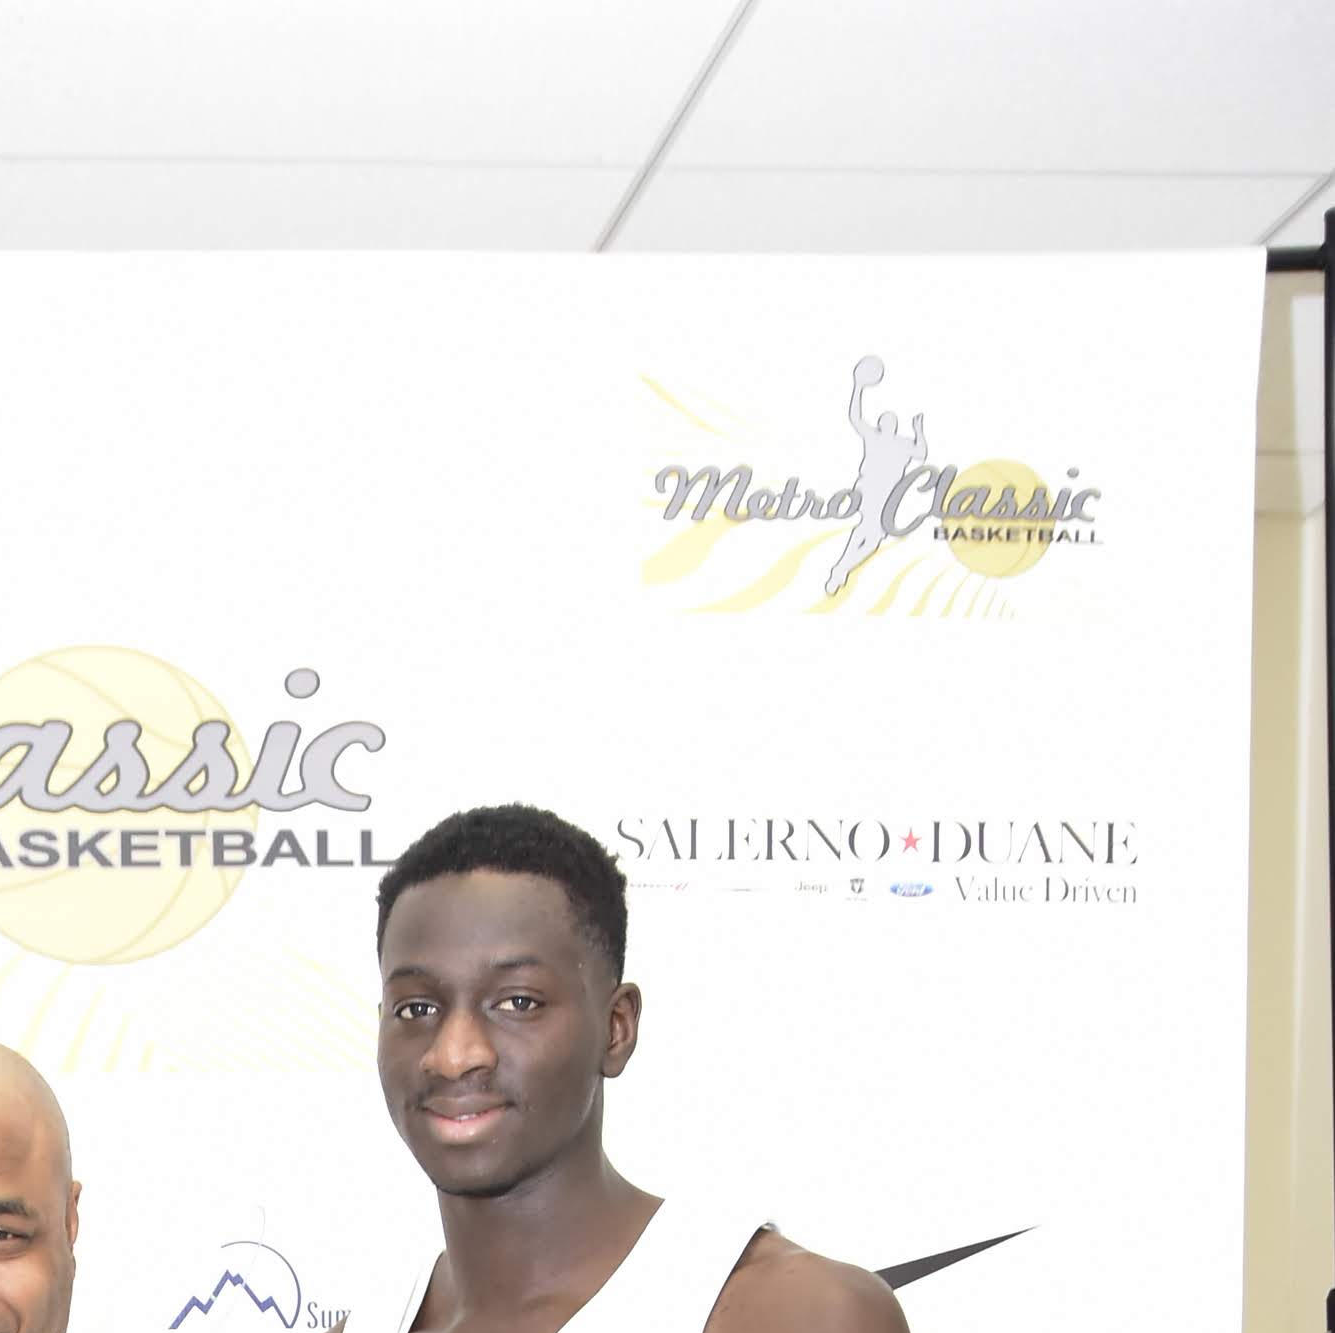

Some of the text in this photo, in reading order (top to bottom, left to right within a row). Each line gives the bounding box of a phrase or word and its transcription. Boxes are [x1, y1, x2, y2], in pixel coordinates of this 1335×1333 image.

[655, 463, 1102, 537] Metro Classic
[933, 526, 1104, 545] BASKETBALL
[616, 817, 1139, 865] SALERNO DUANE
[954, 876, 1034, 904] Value
[1045, 875, 1139, 905] Driven
